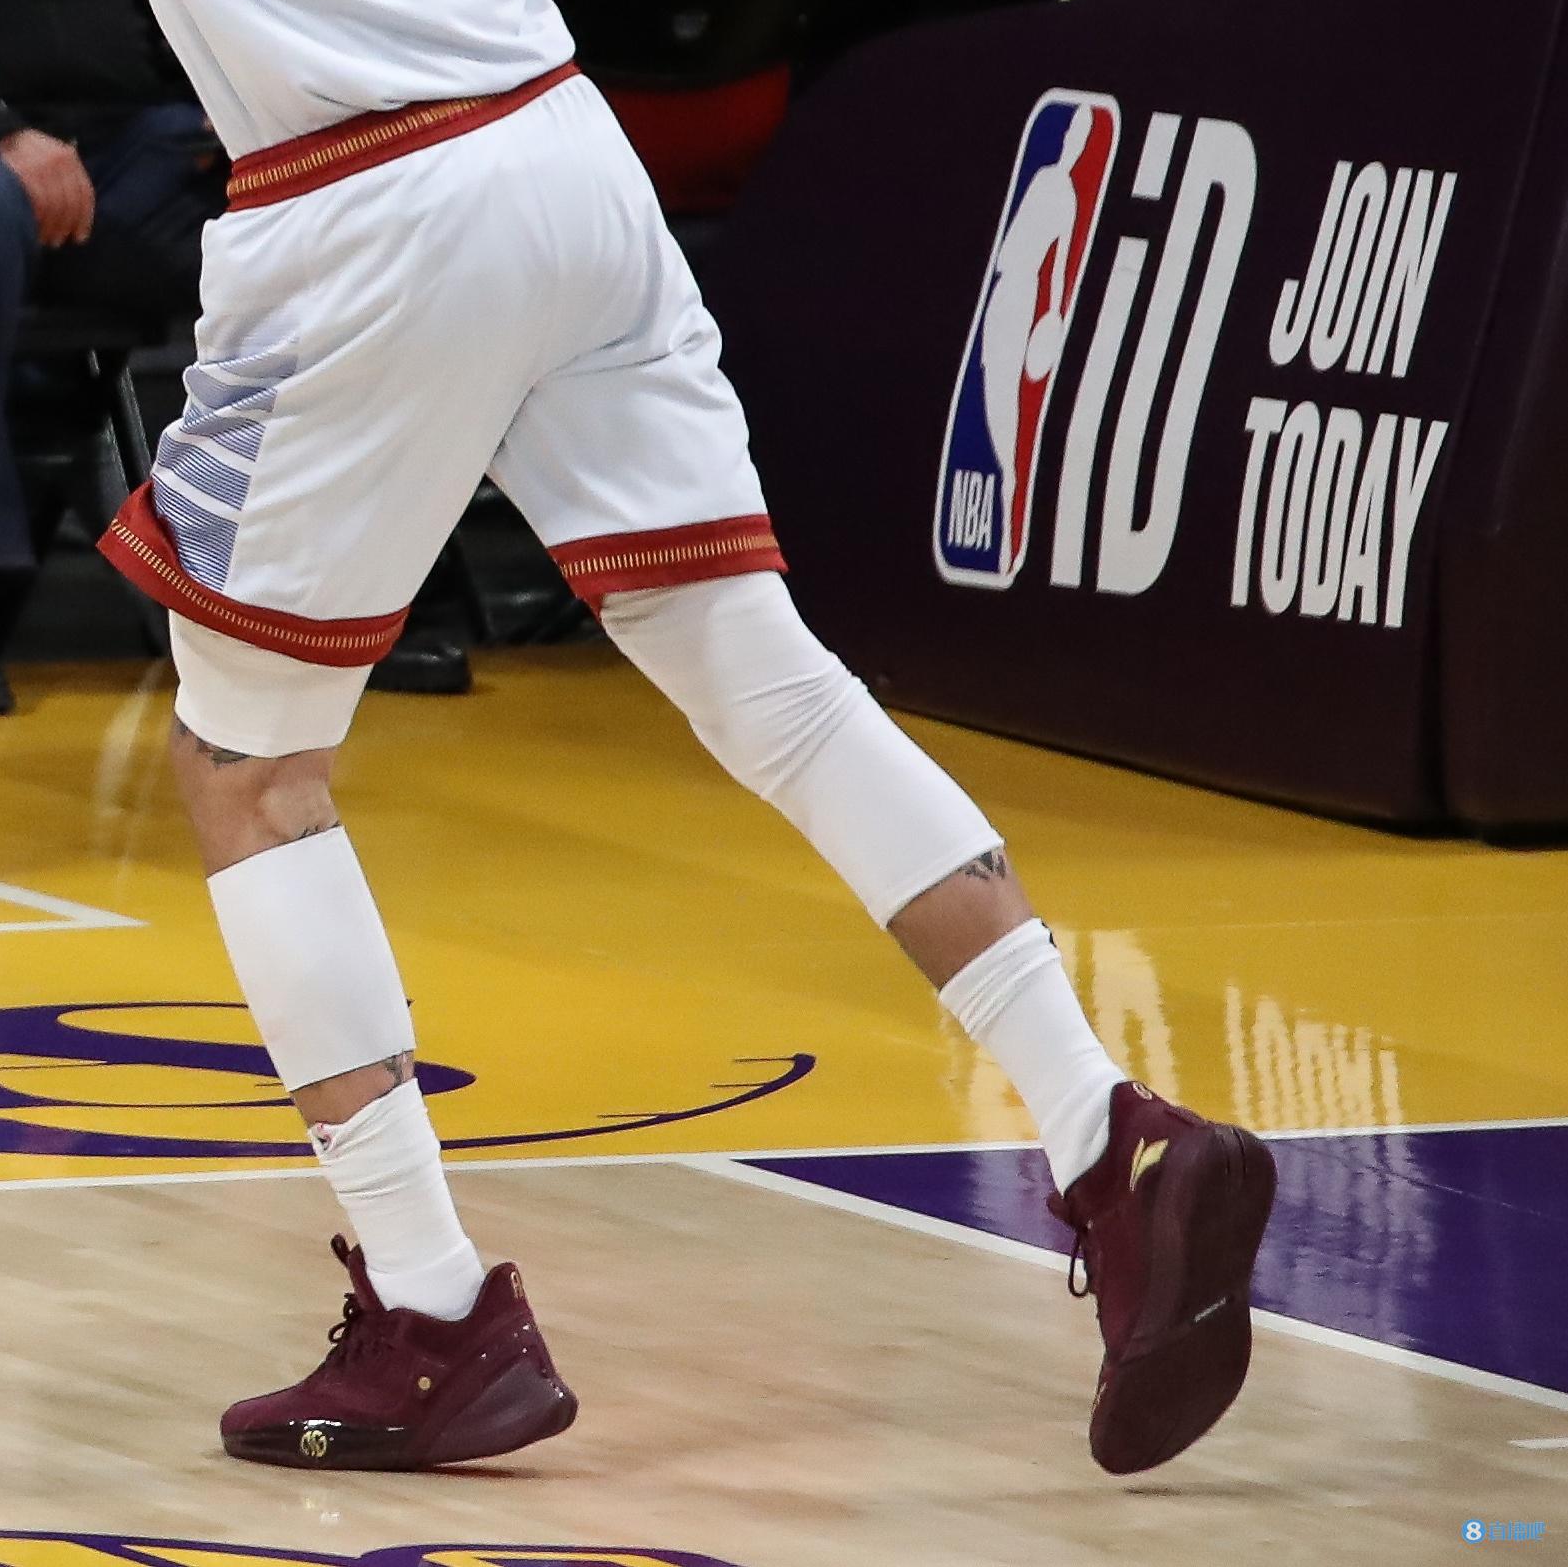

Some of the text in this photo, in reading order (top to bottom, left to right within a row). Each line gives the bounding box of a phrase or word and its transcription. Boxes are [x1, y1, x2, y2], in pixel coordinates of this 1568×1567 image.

[1268, 159, 1458, 379] JOIN
[947, 467, 998, 552] NBA
[1229, 394, 1450, 629] TODAY
